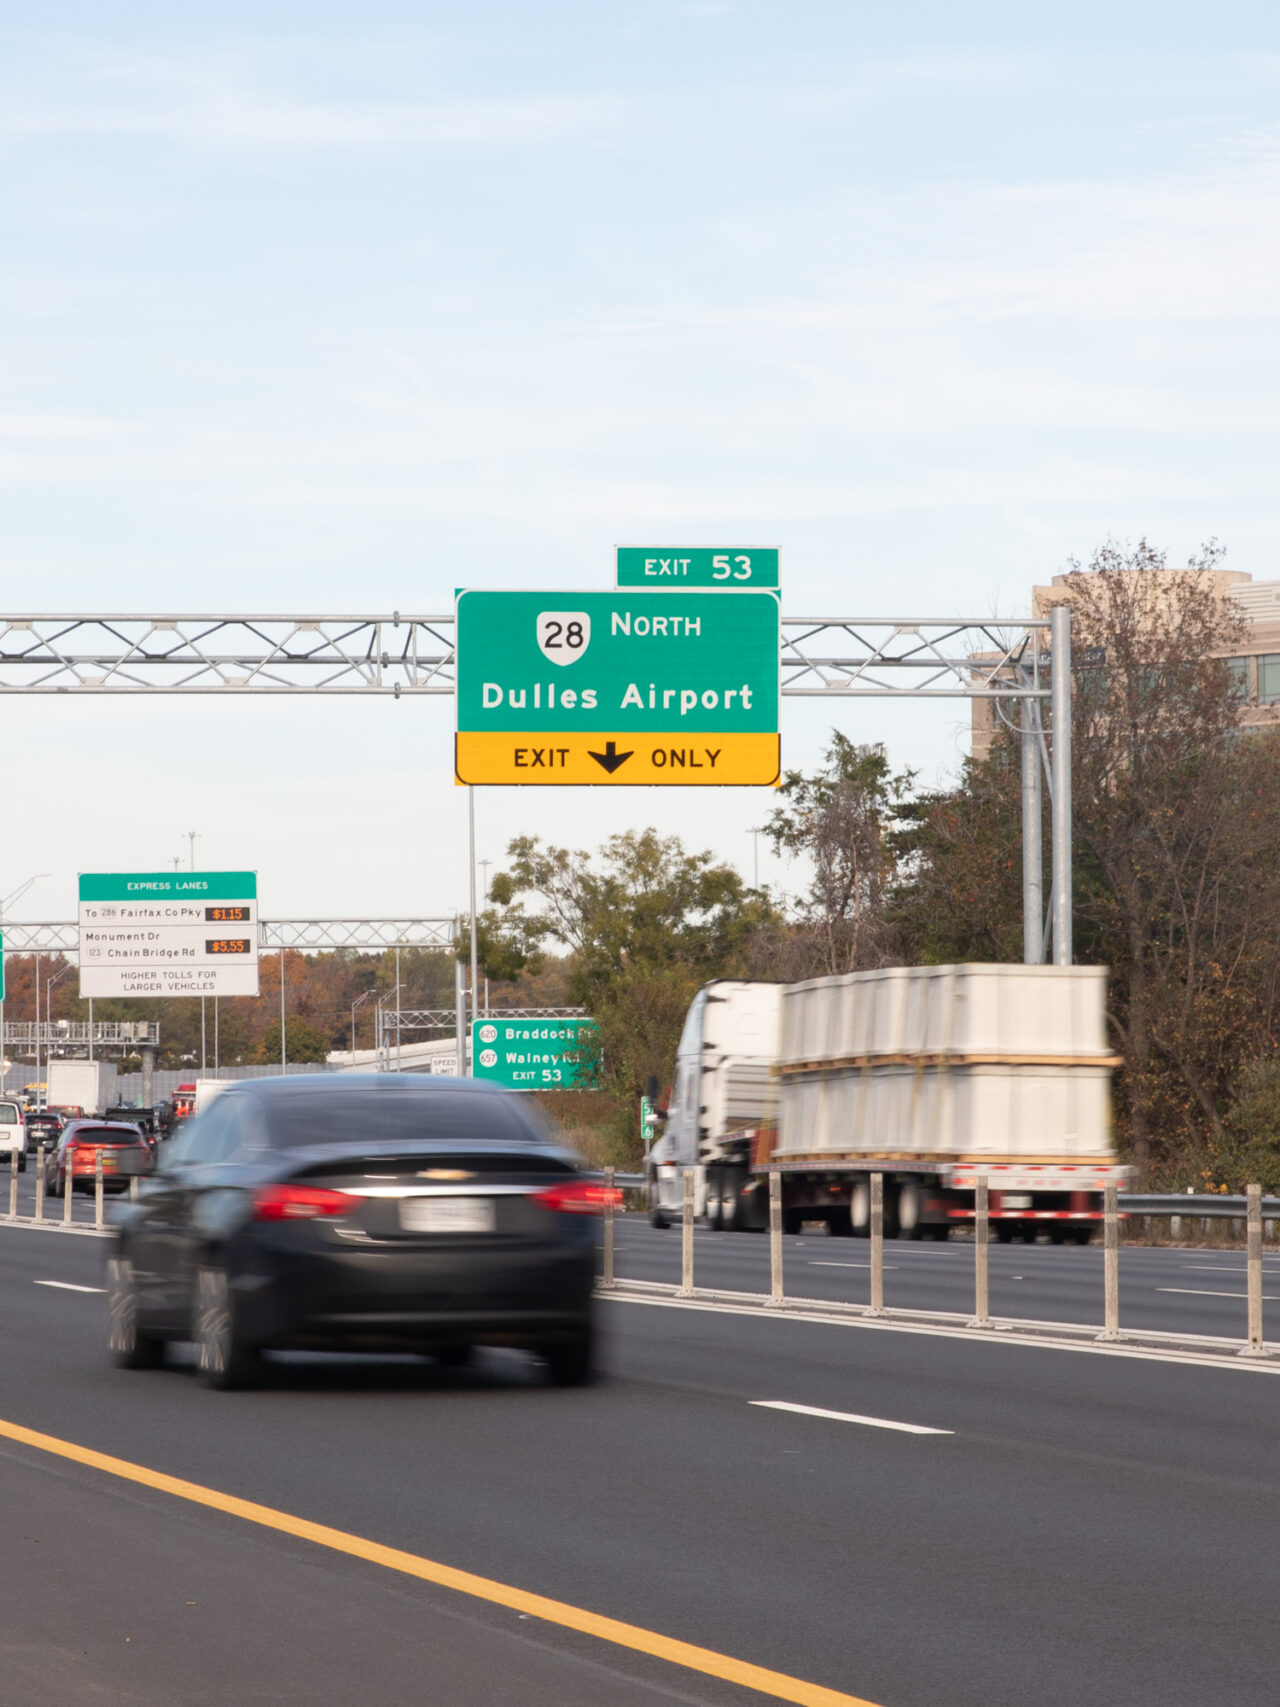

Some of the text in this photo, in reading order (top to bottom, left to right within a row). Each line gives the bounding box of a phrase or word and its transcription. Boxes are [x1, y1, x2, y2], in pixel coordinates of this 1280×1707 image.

[645, 556, 752, 580] EXIT 53
[544, 612, 701, 649] 28 NORTH
[483, 683, 752, 715] Dulles Airport
[515, 750, 721, 767] EXIT ONLY
[127, 882, 208, 891] EXPRESS LANES
[86, 908, 201, 918] To 286 Fairfax Co Pky
[213, 909, 242, 920] $1.15
[86, 933, 145, 941] Monument
[212, 941, 244, 952] $5.55
[108, 949, 140, 957] Chain
[143, 949, 179, 959] Bridge
[121, 972, 157, 980] HIGHER
[198, 971, 217, 979] FOR
[124, 982, 215, 991] LARGER VEHICLES
[480, 1029, 497, 1039] 620
[505, 1028, 574, 1039] Braddock
[480, 1054, 496, 1063] 657
[506, 1053, 559, 1066] Walney
[513, 1070, 562, 1082] EXIT 53
